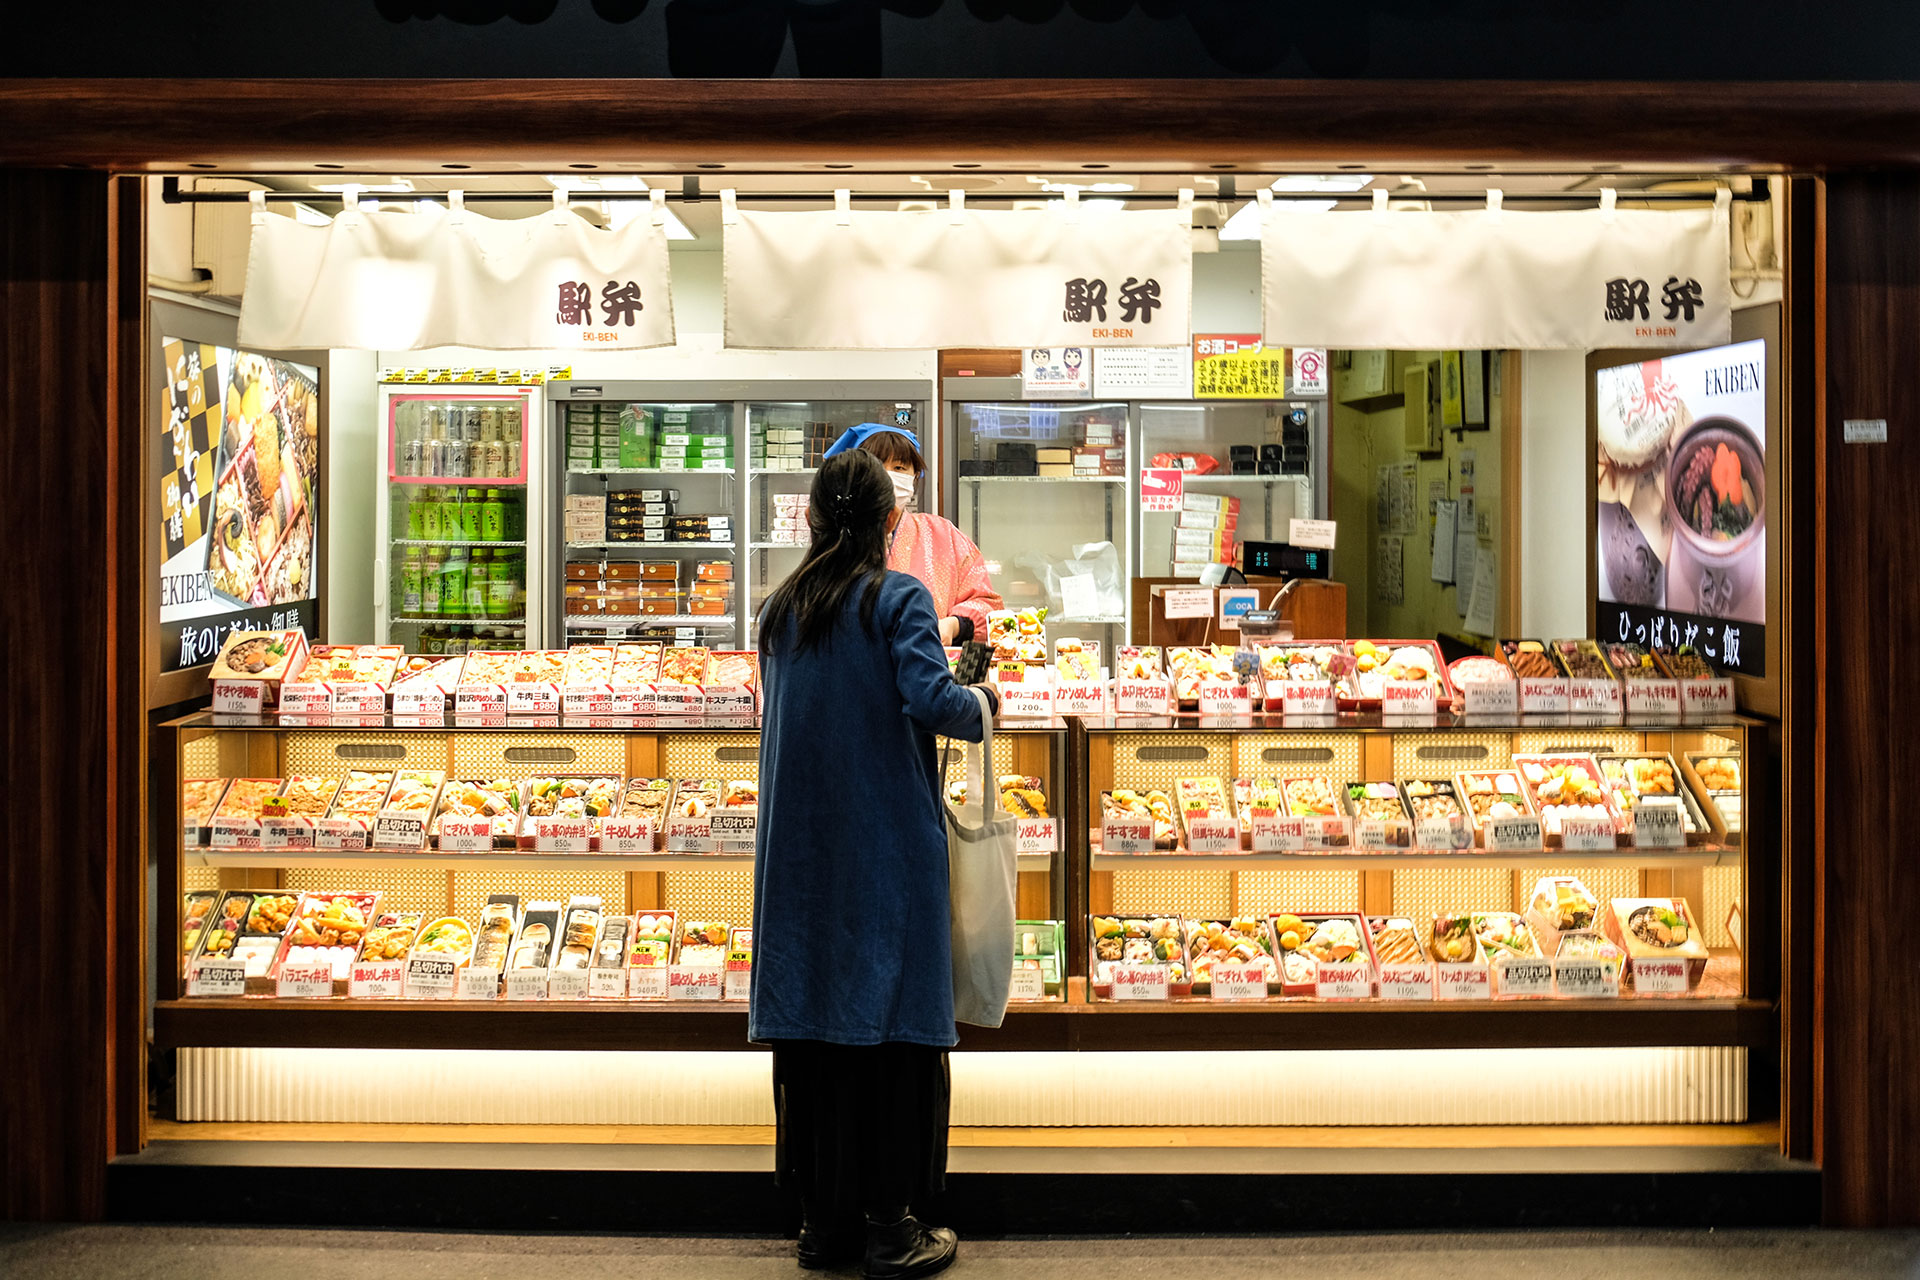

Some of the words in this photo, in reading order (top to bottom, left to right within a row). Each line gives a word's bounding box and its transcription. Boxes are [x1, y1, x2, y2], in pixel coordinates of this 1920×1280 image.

[557, 280, 643, 326] 駅弁
[1063, 277, 1161, 323] 駅弁
[1604, 278, 1704, 321] 駅弁
[583, 332, 618, 341] EKI-BEN
[1092, 328, 1133, 338] EKI-BEN
[1705, 361, 1760, 396] EKIBEN
[160, 570, 215, 607] EKIBEN
[1620, 611, 1740, 666] ひっぱりだこ飯
[379, 819, 420, 831] 品切れ中
[713, 817, 753, 828] 品切れ中
[605, 825, 648, 839] 牛めし丼
[411, 960, 453, 973] 品切れ中
[201, 967, 243, 981] 品切れ中
